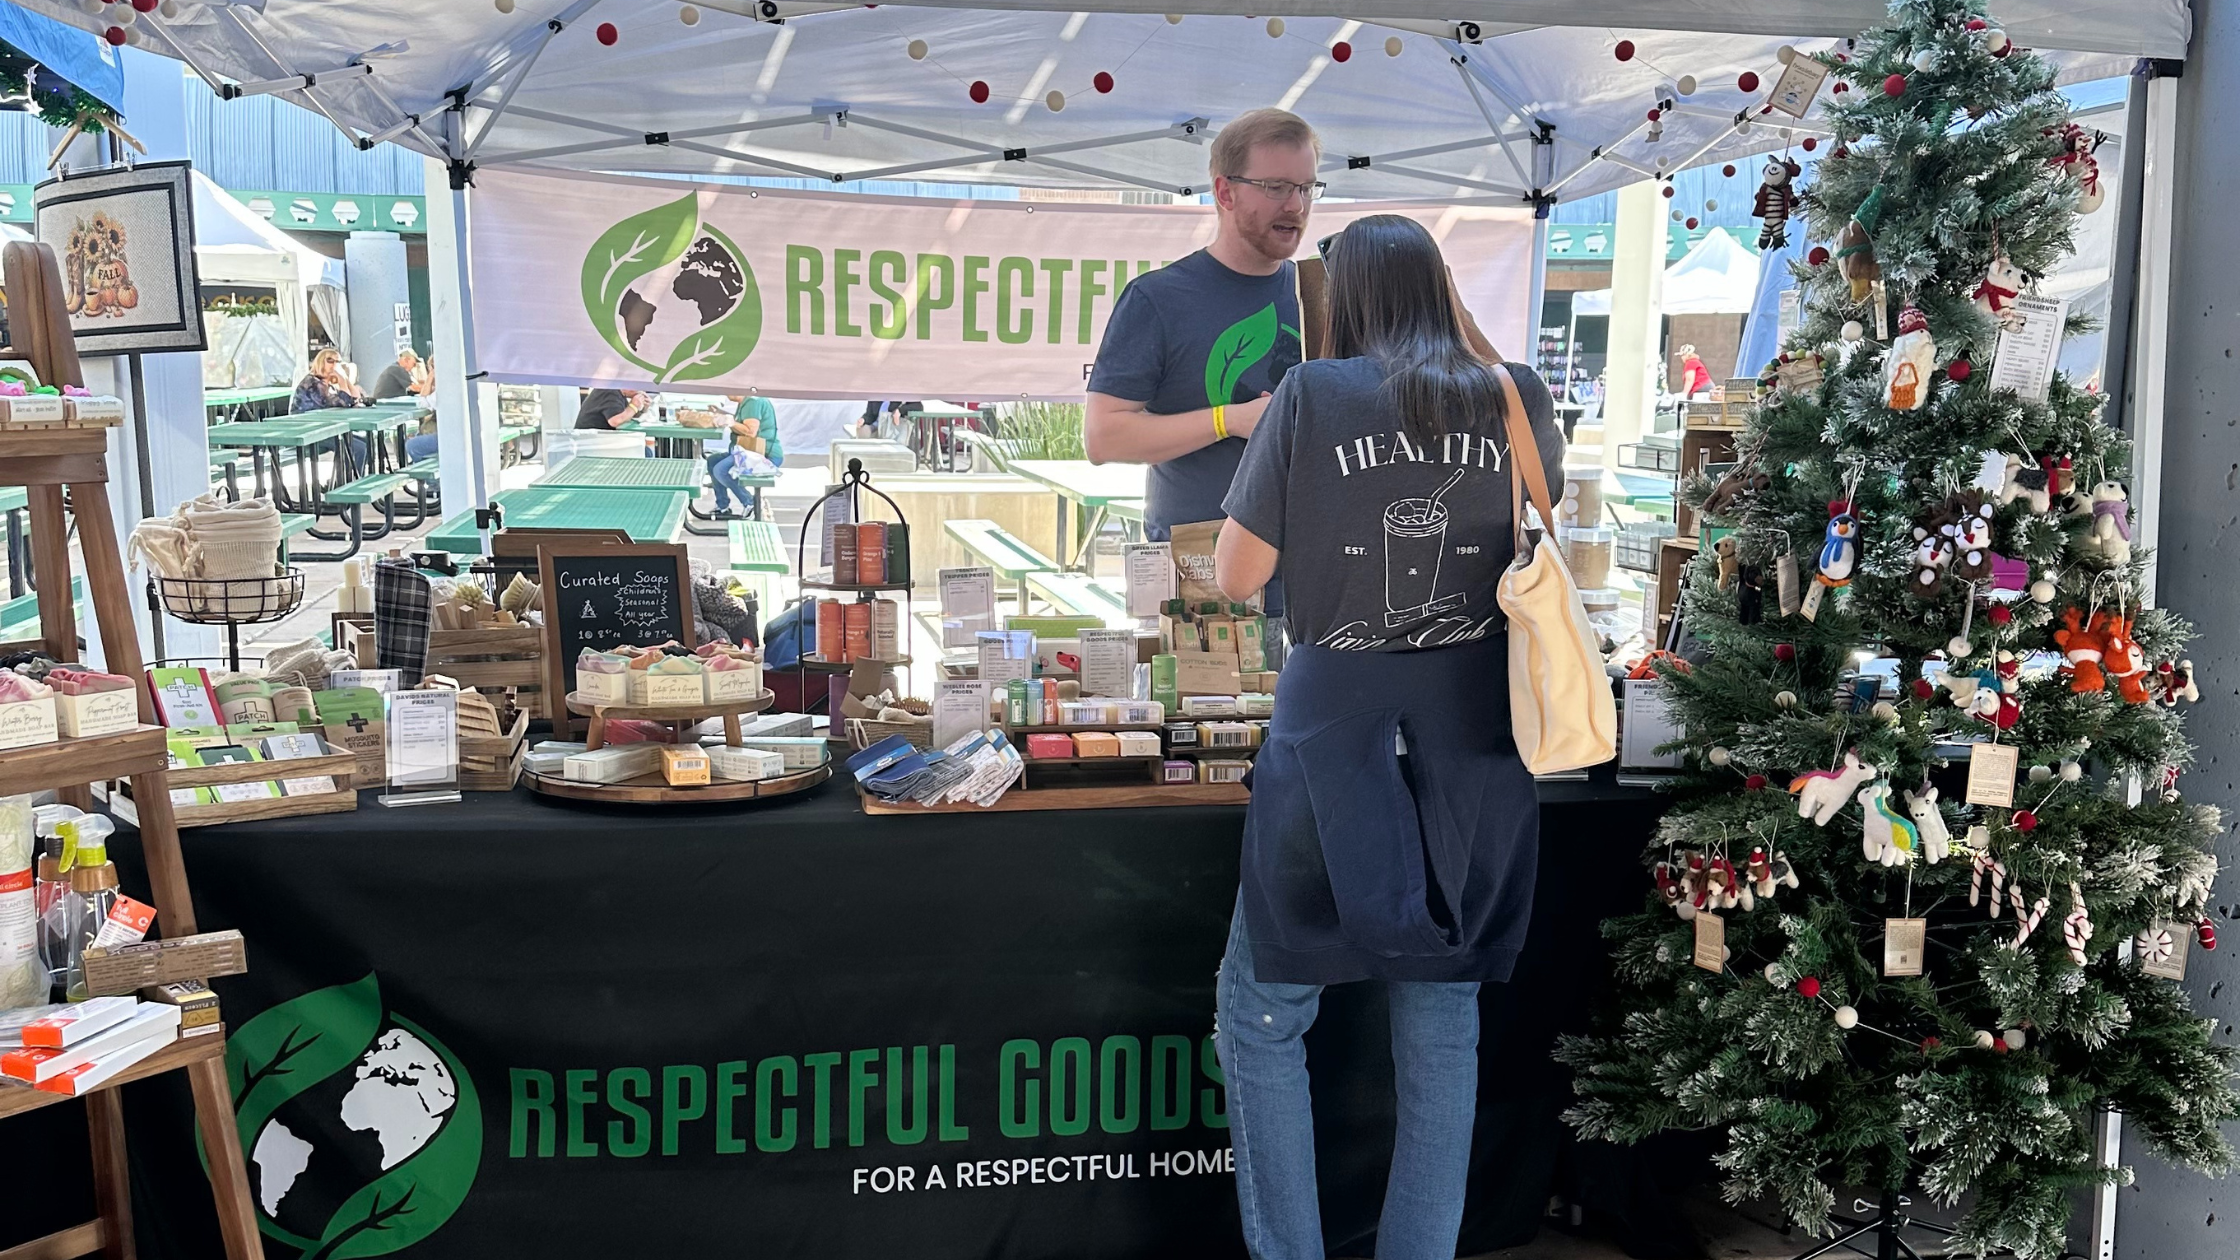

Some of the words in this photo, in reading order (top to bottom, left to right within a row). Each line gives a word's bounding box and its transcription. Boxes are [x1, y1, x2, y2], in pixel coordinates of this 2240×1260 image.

[98, 268, 122, 281] FALL
[786, 244, 1172, 345] RESPECTF
[2018, 301, 2058, 312] ORNAMENTS
[1335, 431, 1510, 477] HEALTHY
[1344, 546, 1368, 556] EST.
[1456, 545, 1480, 555] 1980
[560, 571, 620, 589] Curated
[633, 570, 669, 588] Soaps
[624, 598, 659, 606] Seasonal
[638, 612, 656, 620] year
[344, 734, 381, 743] MOSQUITO
[347, 740, 381, 749] STICKERS
[508, 1043, 970, 1159] RESPECTFUL
[999, 1034, 1231, 1140] GOODS
[853, 1167, 917, 1194] FOR
[925, 1164, 947, 1190] A
[956, 1153, 1142, 1187] RESPECTFUL
[1150, 1149, 1237, 1178] HOME
